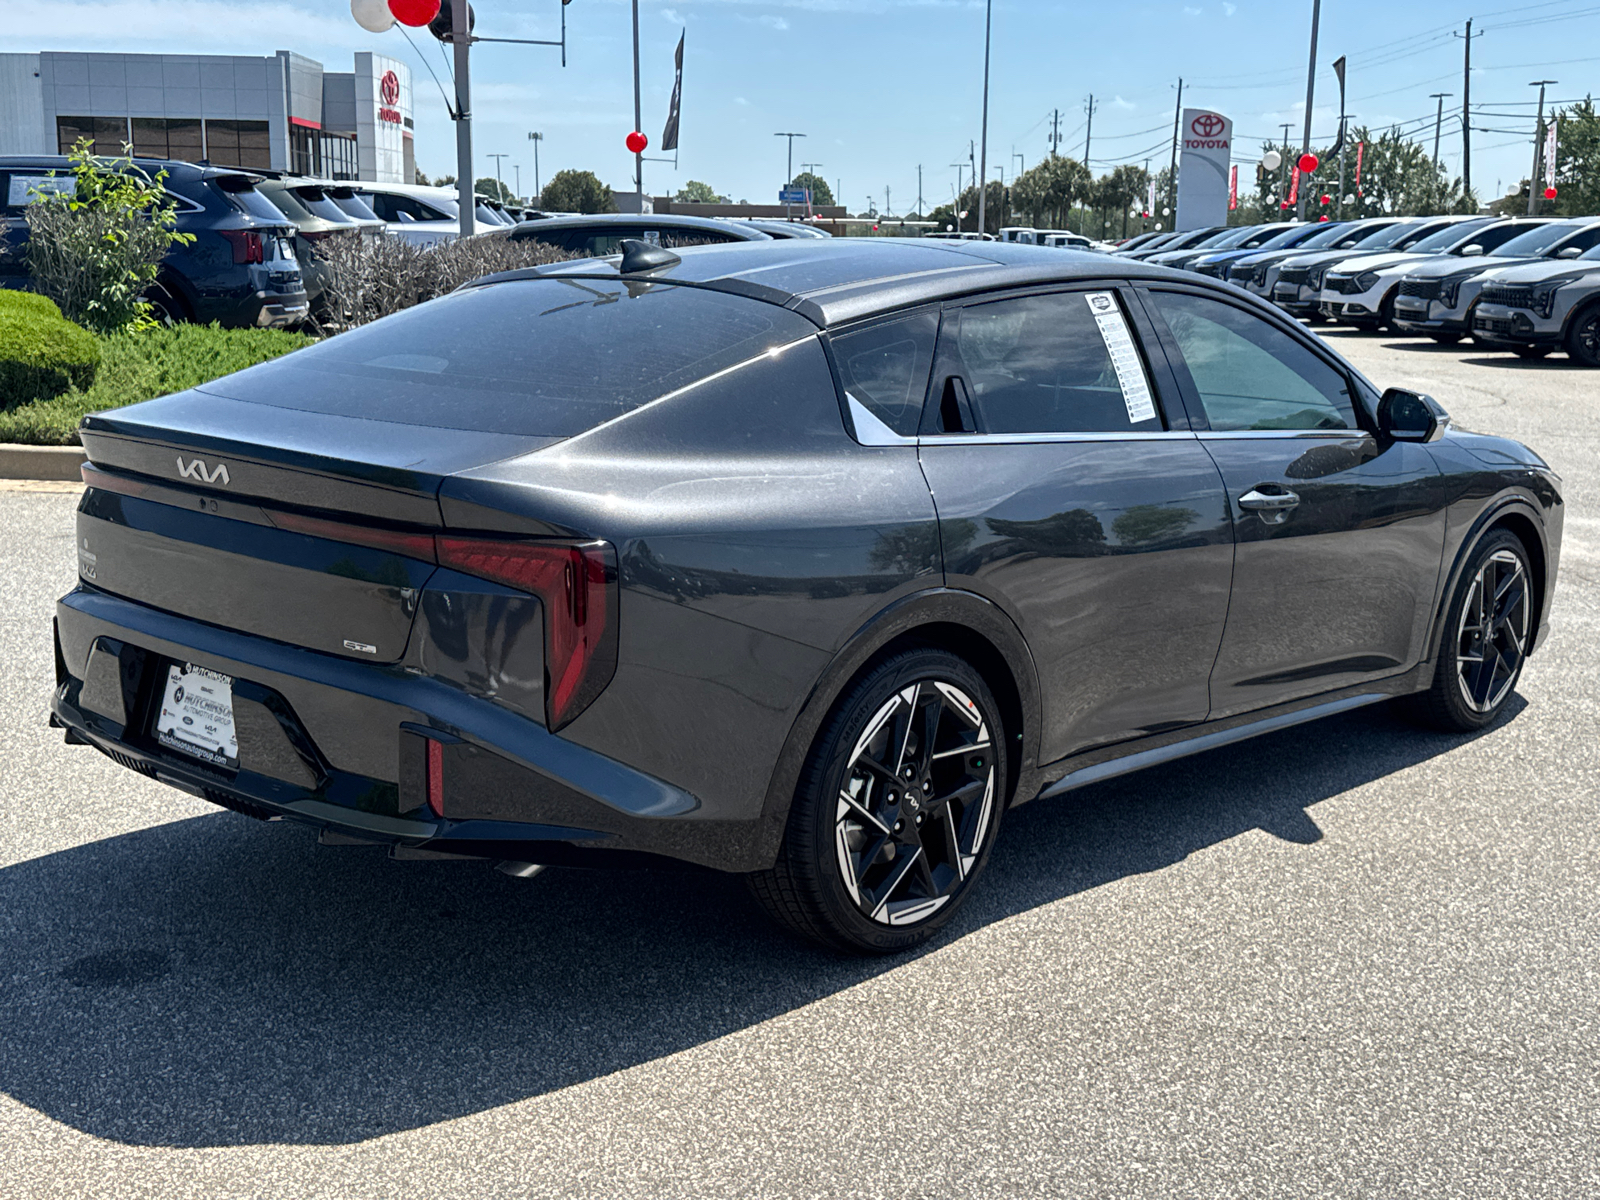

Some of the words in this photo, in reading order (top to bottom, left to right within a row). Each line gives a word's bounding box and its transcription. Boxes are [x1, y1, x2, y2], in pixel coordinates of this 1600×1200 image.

[379, 108, 402, 124] TOYOTA
[1185, 139, 1229, 149] TOYOTA
[176, 455, 230, 486] KIA
[192, 666, 231, 684] HUTCHINSON
[183, 705, 213, 721] AUTOMOTIVE
[214, 714, 232, 726] GROUP
